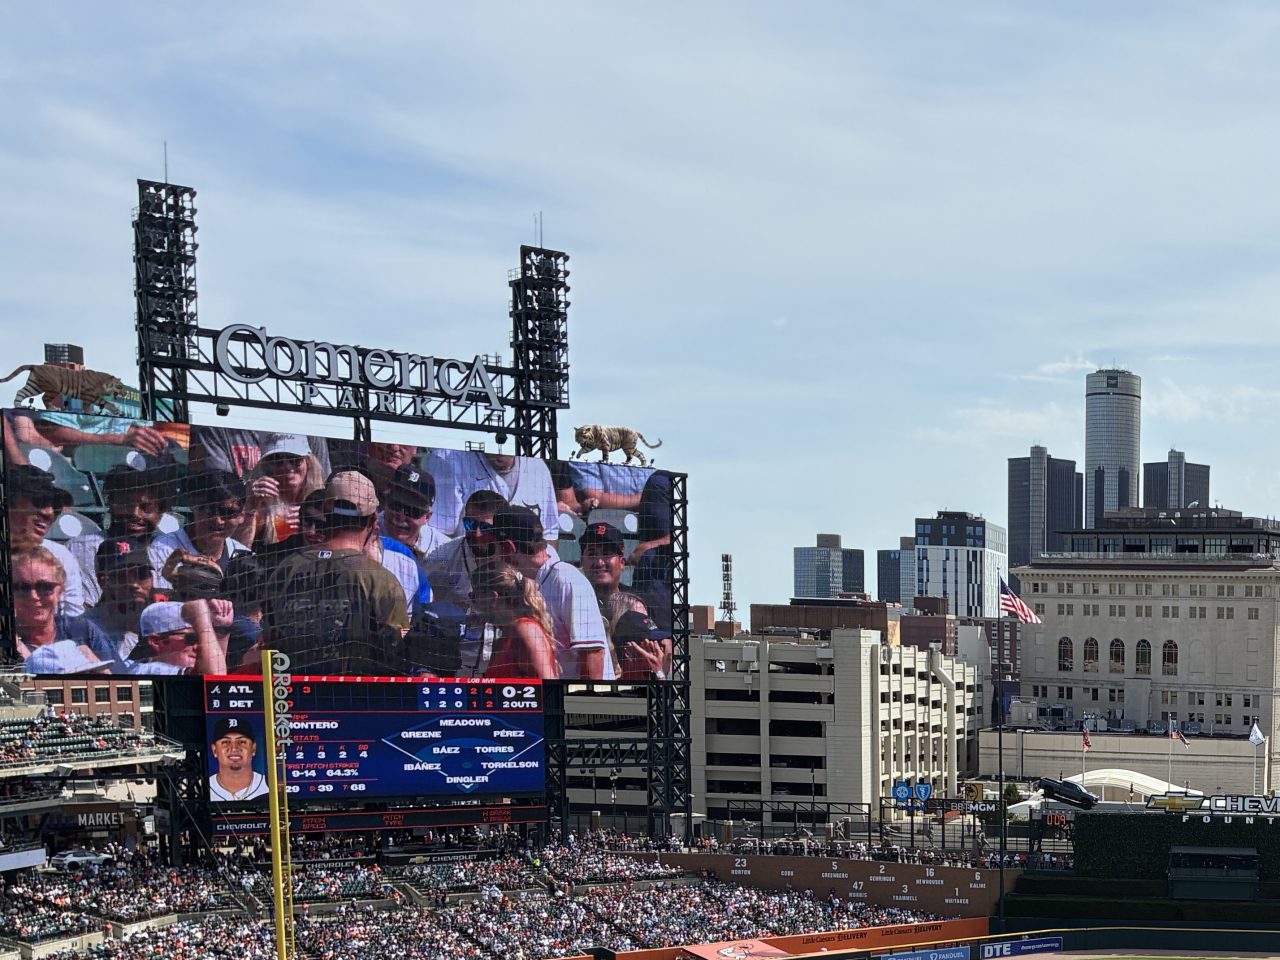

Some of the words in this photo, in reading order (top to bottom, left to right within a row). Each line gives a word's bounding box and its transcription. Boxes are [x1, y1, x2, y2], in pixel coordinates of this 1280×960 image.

[301, 383, 434, 418] PARK
[228, 685, 254, 694] ATL
[303, 686, 311, 694] 3
[422, 687, 430, 695] 3
[438, 687, 447, 695] 2
[454, 687, 463, 695] 0
[502, 686, 536, 698] 0-2
[229, 700, 254, 708] DET
[493, 729, 525, 737] PÉREZ
[432, 746, 460, 754] BÁEZ
[481, 761, 539, 769] TORKELSON
[326, 769, 358, 777] 64.3%
[286, 785, 300, 793] 29
[78, 812, 125, 826] MARKET
[216, 822, 267, 831] CHEVROLET
[432, 854, 477, 863] CHEVROLET
[735, 858, 747, 867] 23
[305, 861, 354, 870] CHEVROLET
[831, 862, 838, 870] 5
[879, 865, 885, 873] 2
[925, 868, 935, 877] 16
[974, 872, 981, 880] 6
[852, 881, 864, 890] 47
[902, 885, 908, 893] 3
[893, 927, 913, 935] Caesars
[914, 924, 943, 933] DELIVERY
[814, 935, 836, 944] Caesars
[837, 932, 868, 942] DELIVERY
[938, 951, 965, 960] FANDUEL
[984, 944, 1012, 958] DTE
